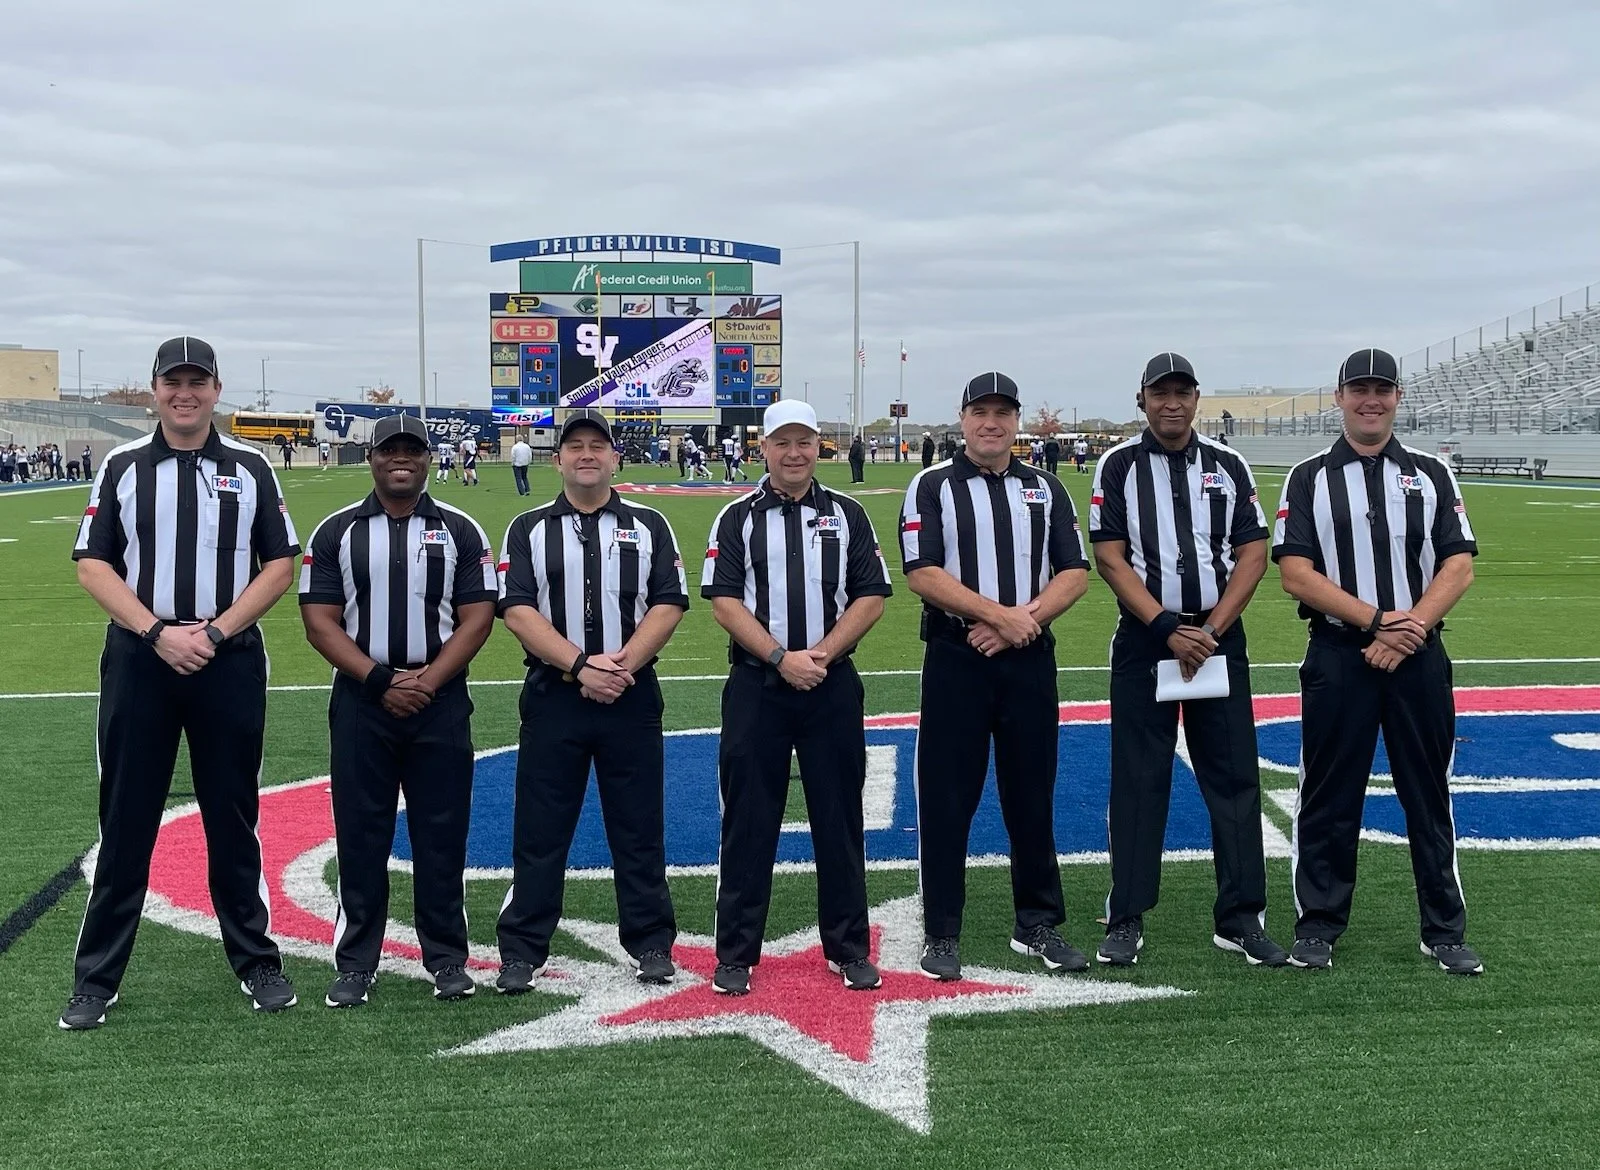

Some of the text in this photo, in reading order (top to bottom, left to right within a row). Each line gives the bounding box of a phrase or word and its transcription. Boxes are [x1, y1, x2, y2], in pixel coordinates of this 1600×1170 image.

[538, 235, 735, 255] PFLUGERVILLE ISD
[595, 275, 702, 285] ederal Credit Union
[576, 323, 619, 368] SV
[647, 345, 678, 371] Station
[675, 324, 713, 353] Cougars
[534, 358, 543, 372] 0
[605, 358, 633, 381] Valley
[740, 359, 749, 373] 0
[324, 405, 355, 438] SV
[427, 422, 482, 435] ngers
